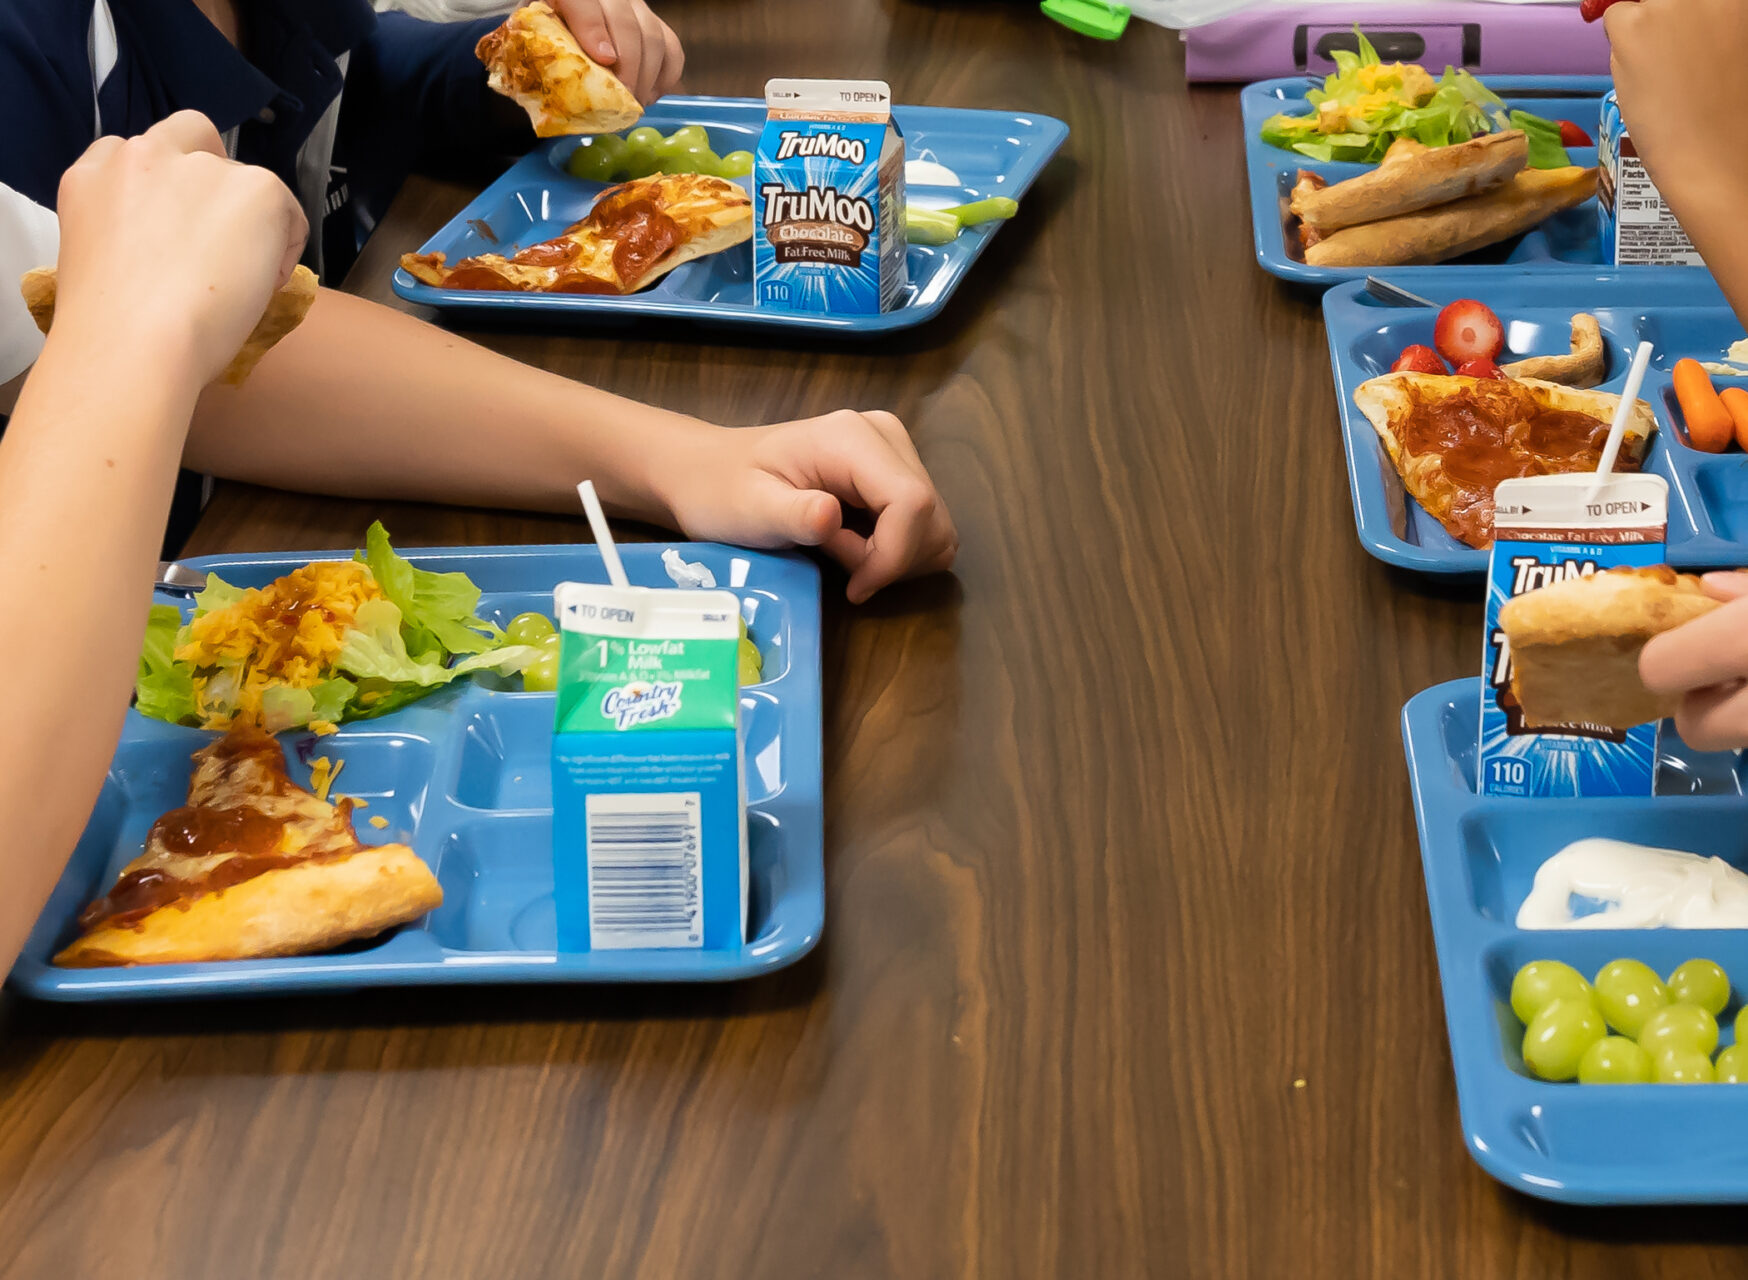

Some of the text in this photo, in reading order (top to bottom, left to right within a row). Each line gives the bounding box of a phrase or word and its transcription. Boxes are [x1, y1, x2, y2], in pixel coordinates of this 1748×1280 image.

[840, 92, 877, 103] TO OPEN
[776, 130, 866, 165] TruMoo
[1622, 169, 1645, 179] Facts
[761, 184, 874, 233] TruMoo
[1644, 200, 1659, 209] 110
[780, 225, 854, 243] Chocolate
[784, 246, 852, 262] Fat Free Milk
[766, 284, 789, 301] 110
[1587, 501, 1638, 517] TO OPEN
[1567, 532, 1586, 542] Fat
[1618, 530, 1646, 542] Milk
[1512, 557, 1606, 595] TruM
[582, 604, 635, 623] TO OPEN
[627, 640, 685, 656] Lowfat
[627, 655, 663, 670] Milk
[604, 684, 678, 715] Country
[618, 699, 668, 728] Fresh
[1492, 760, 1525, 785] 110
